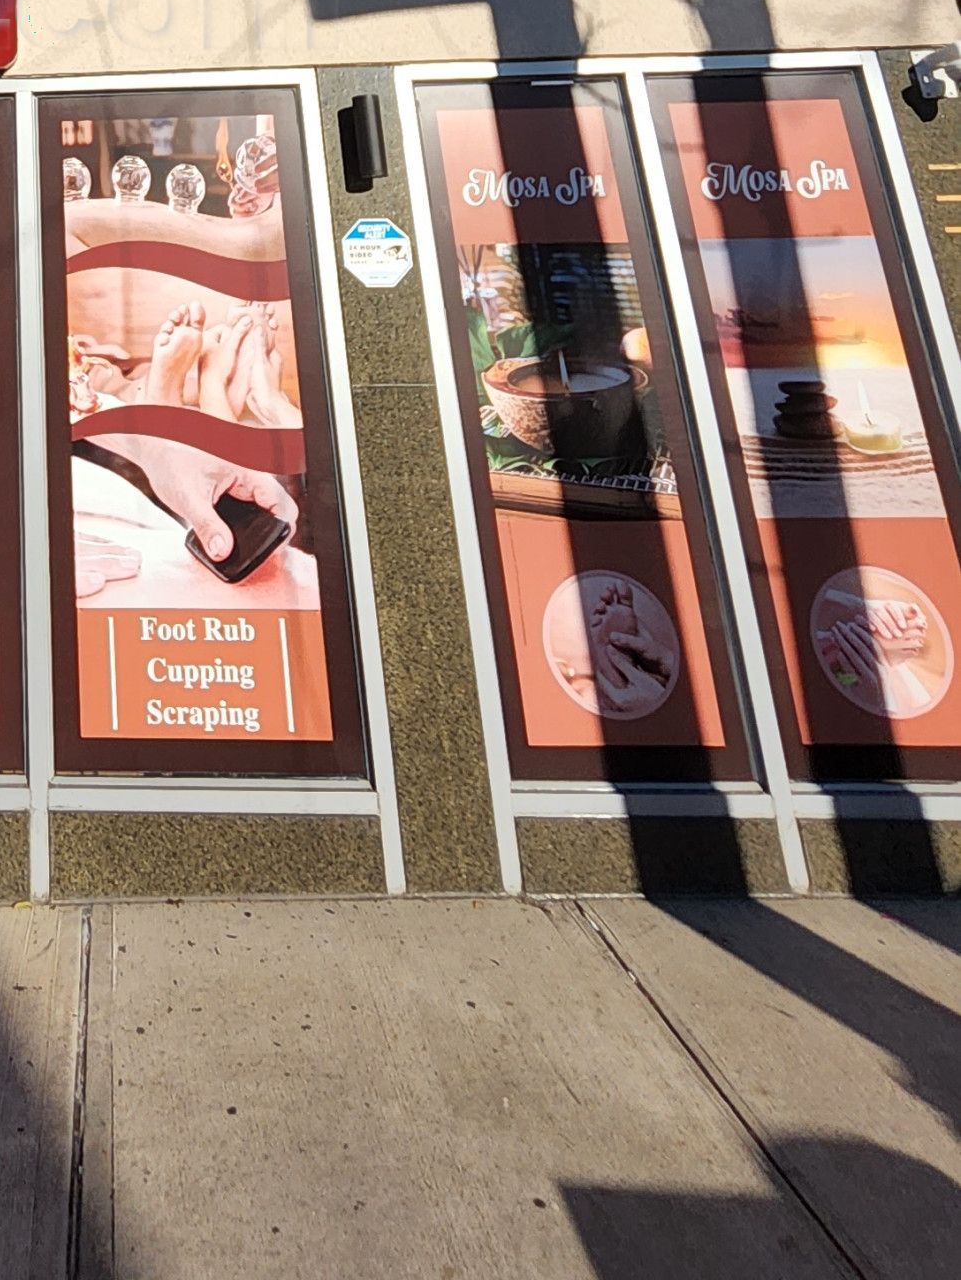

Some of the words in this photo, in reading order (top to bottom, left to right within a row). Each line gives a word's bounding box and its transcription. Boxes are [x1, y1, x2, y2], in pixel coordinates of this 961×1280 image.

[139, 616, 196, 641] Foot
[202, 617, 255, 642] Rub
[147, 657, 255, 689] Cupping
[146, 699, 260, 732] Scraping
